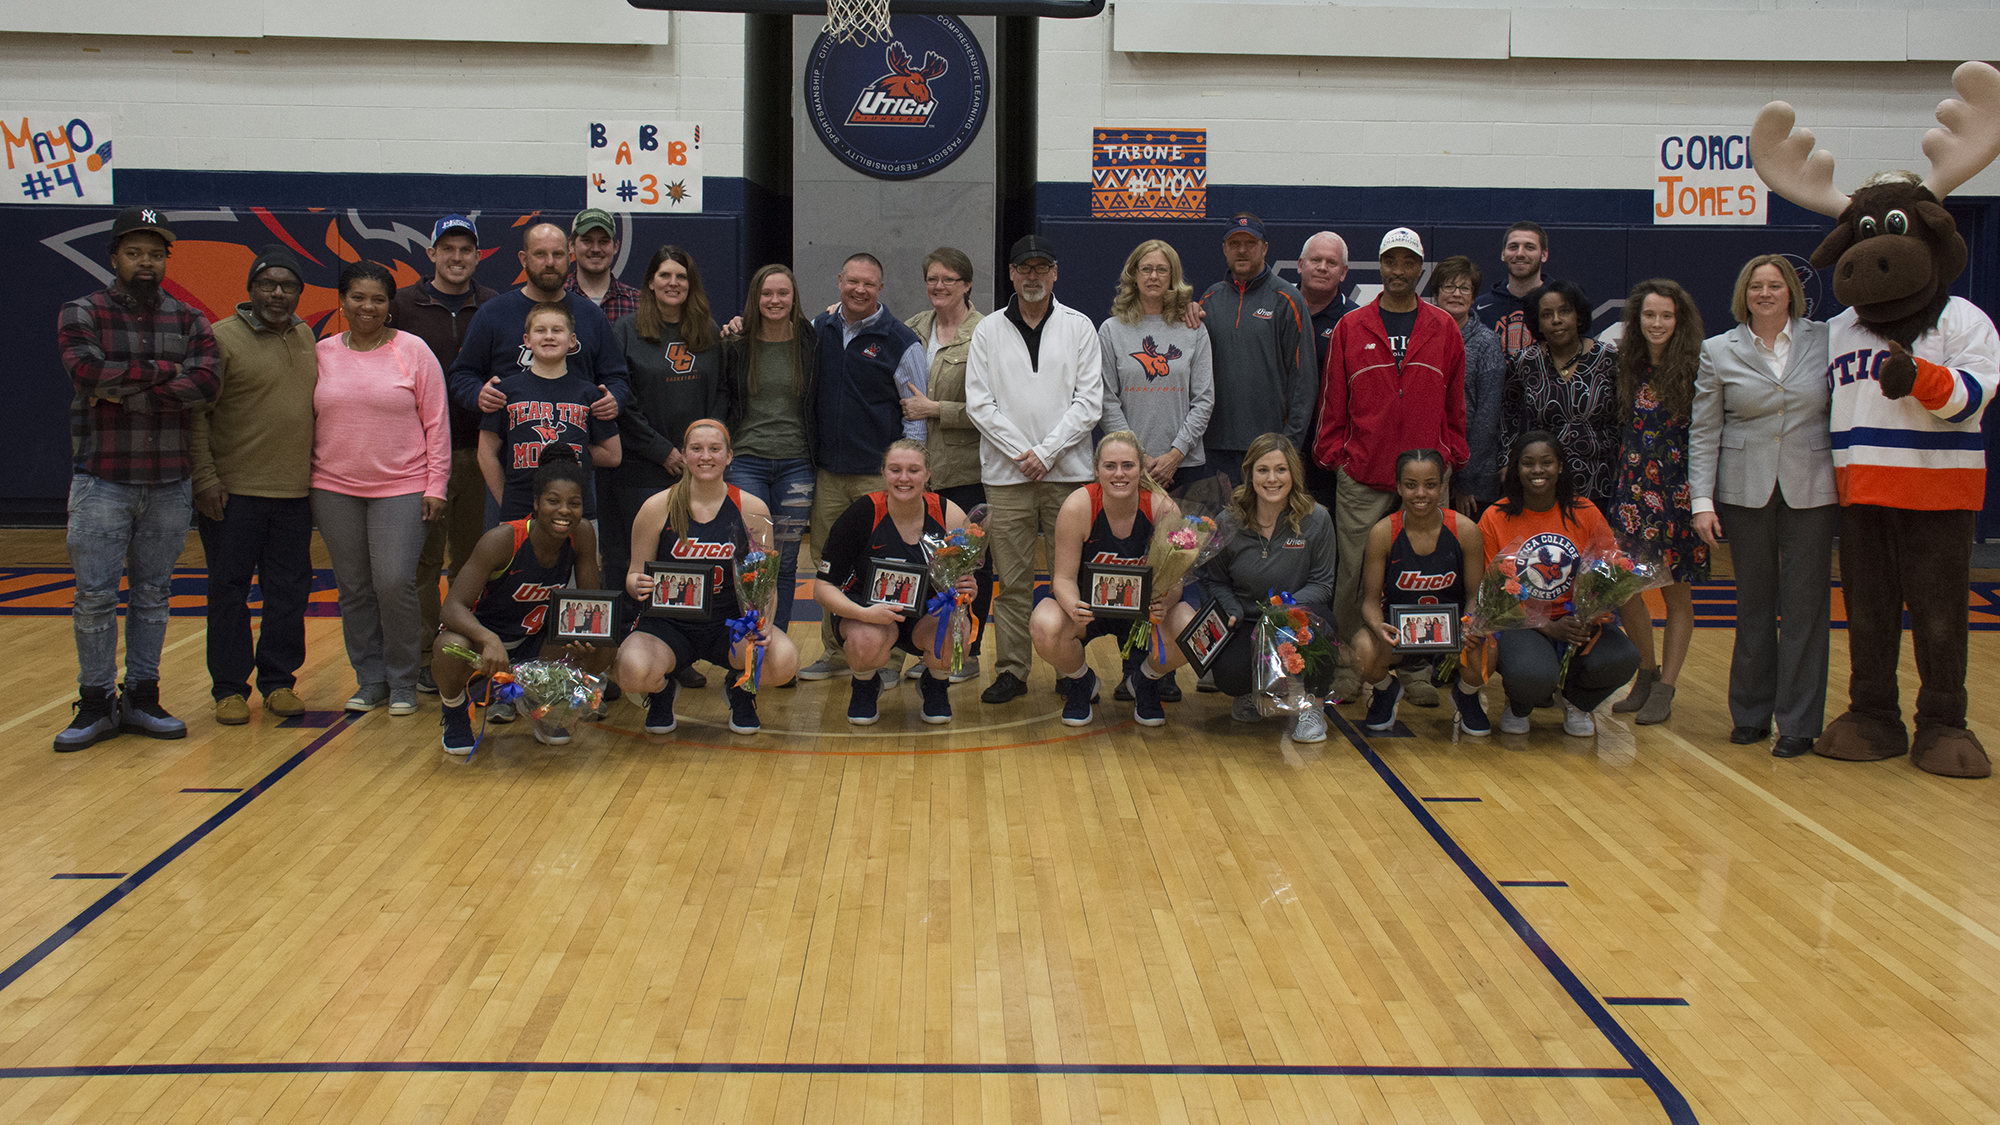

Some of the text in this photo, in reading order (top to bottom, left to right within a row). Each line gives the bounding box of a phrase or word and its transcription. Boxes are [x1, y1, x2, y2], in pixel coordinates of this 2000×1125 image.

[936, 14, 982, 130] COMPREHENSIVE LEARNING
[812, 69, 840, 144] SPORTSMANSHIP
[844, 149, 918, 172] RESPONSIBILITY
[928, 137, 962, 164] PASSION
[1103, 145, 1183, 160] TABONE
[21, 162, 85, 200] #4
[616, 174, 659, 205] #3
[1127, 174, 1186, 198] #40
[507, 401, 590, 433] FEAR THE
[670, 537, 736, 560] UTICA
[1541, 535, 1579, 560] COLLEGE
[1395, 570, 1457, 591] UTICA
[521, 604, 549, 635] 4
